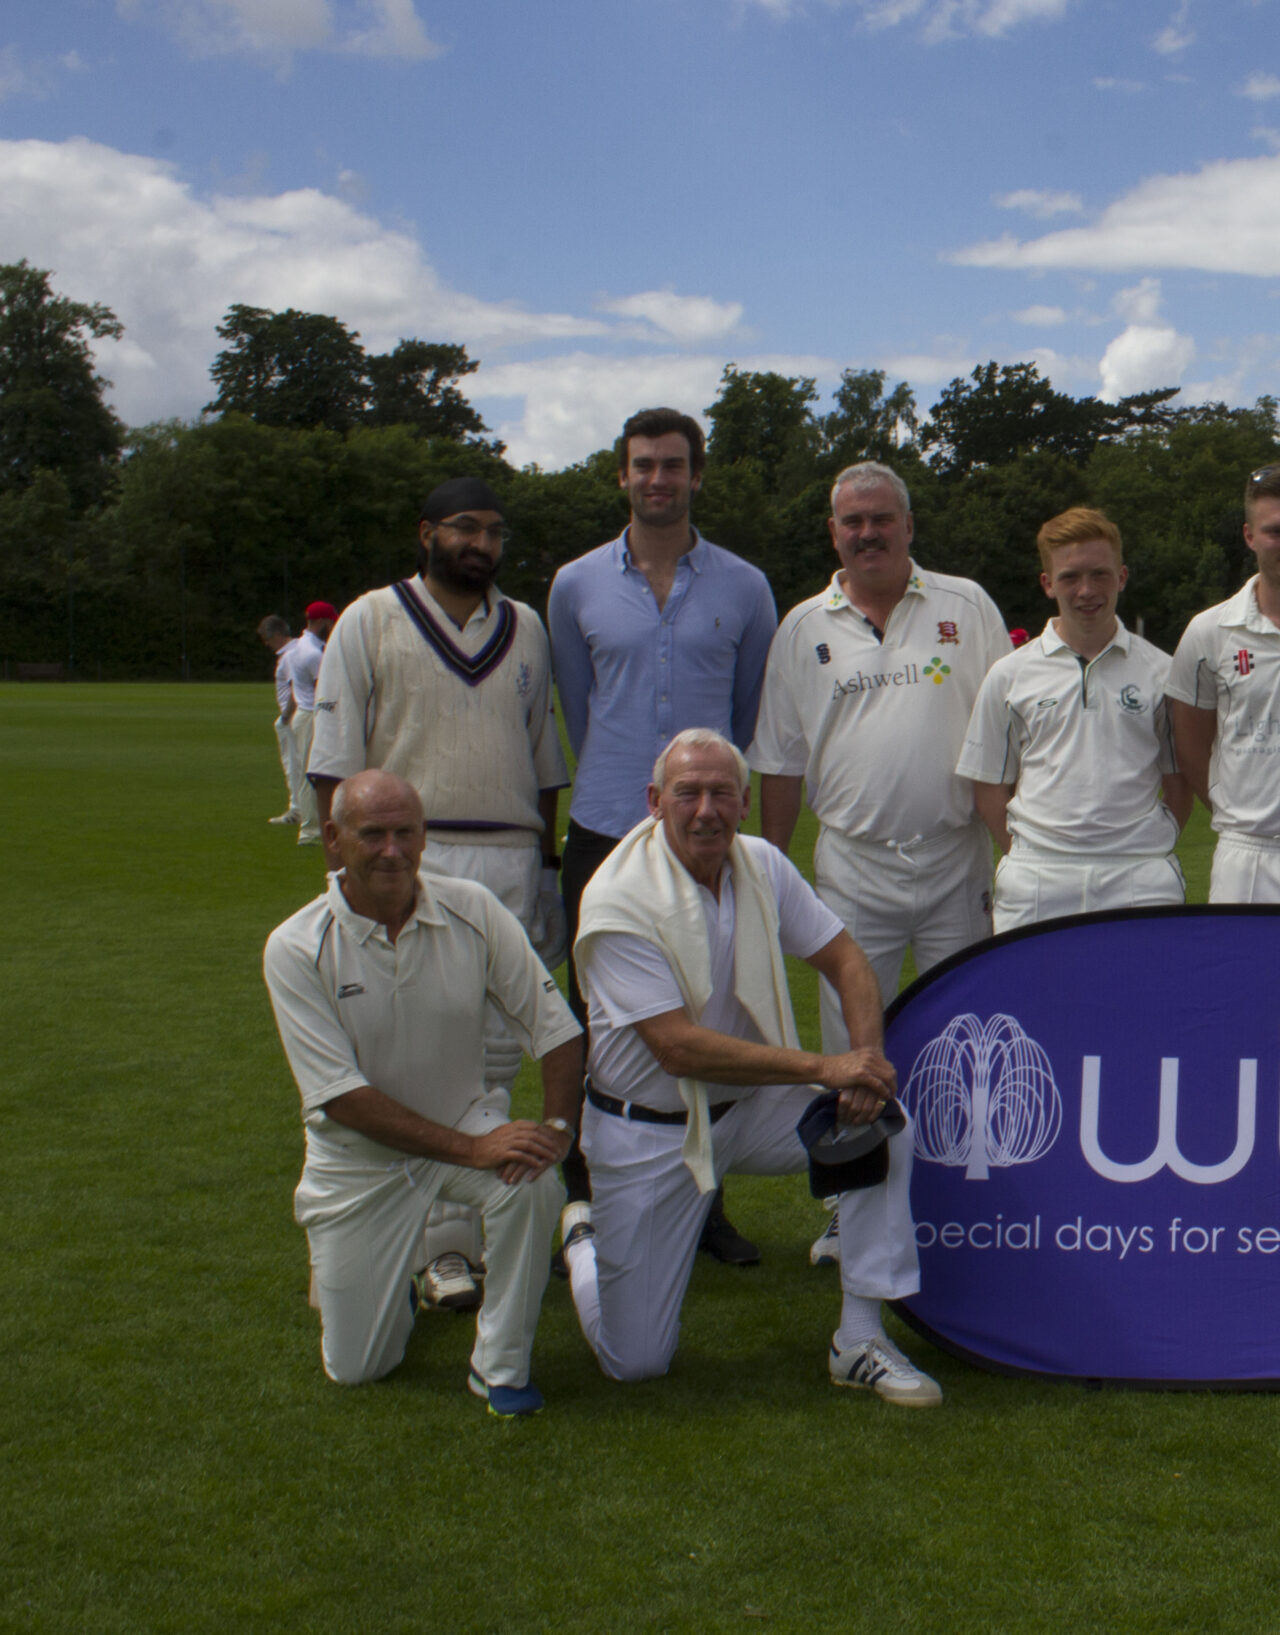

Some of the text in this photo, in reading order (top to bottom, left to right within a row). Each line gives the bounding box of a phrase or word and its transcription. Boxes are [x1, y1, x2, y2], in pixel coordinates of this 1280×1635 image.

[832, 663, 918, 699] Ashwell
[911, 1214, 1040, 1249] pecial
[1055, 1216, 1154, 1260] days
[1168, 1217, 1226, 1253] for
